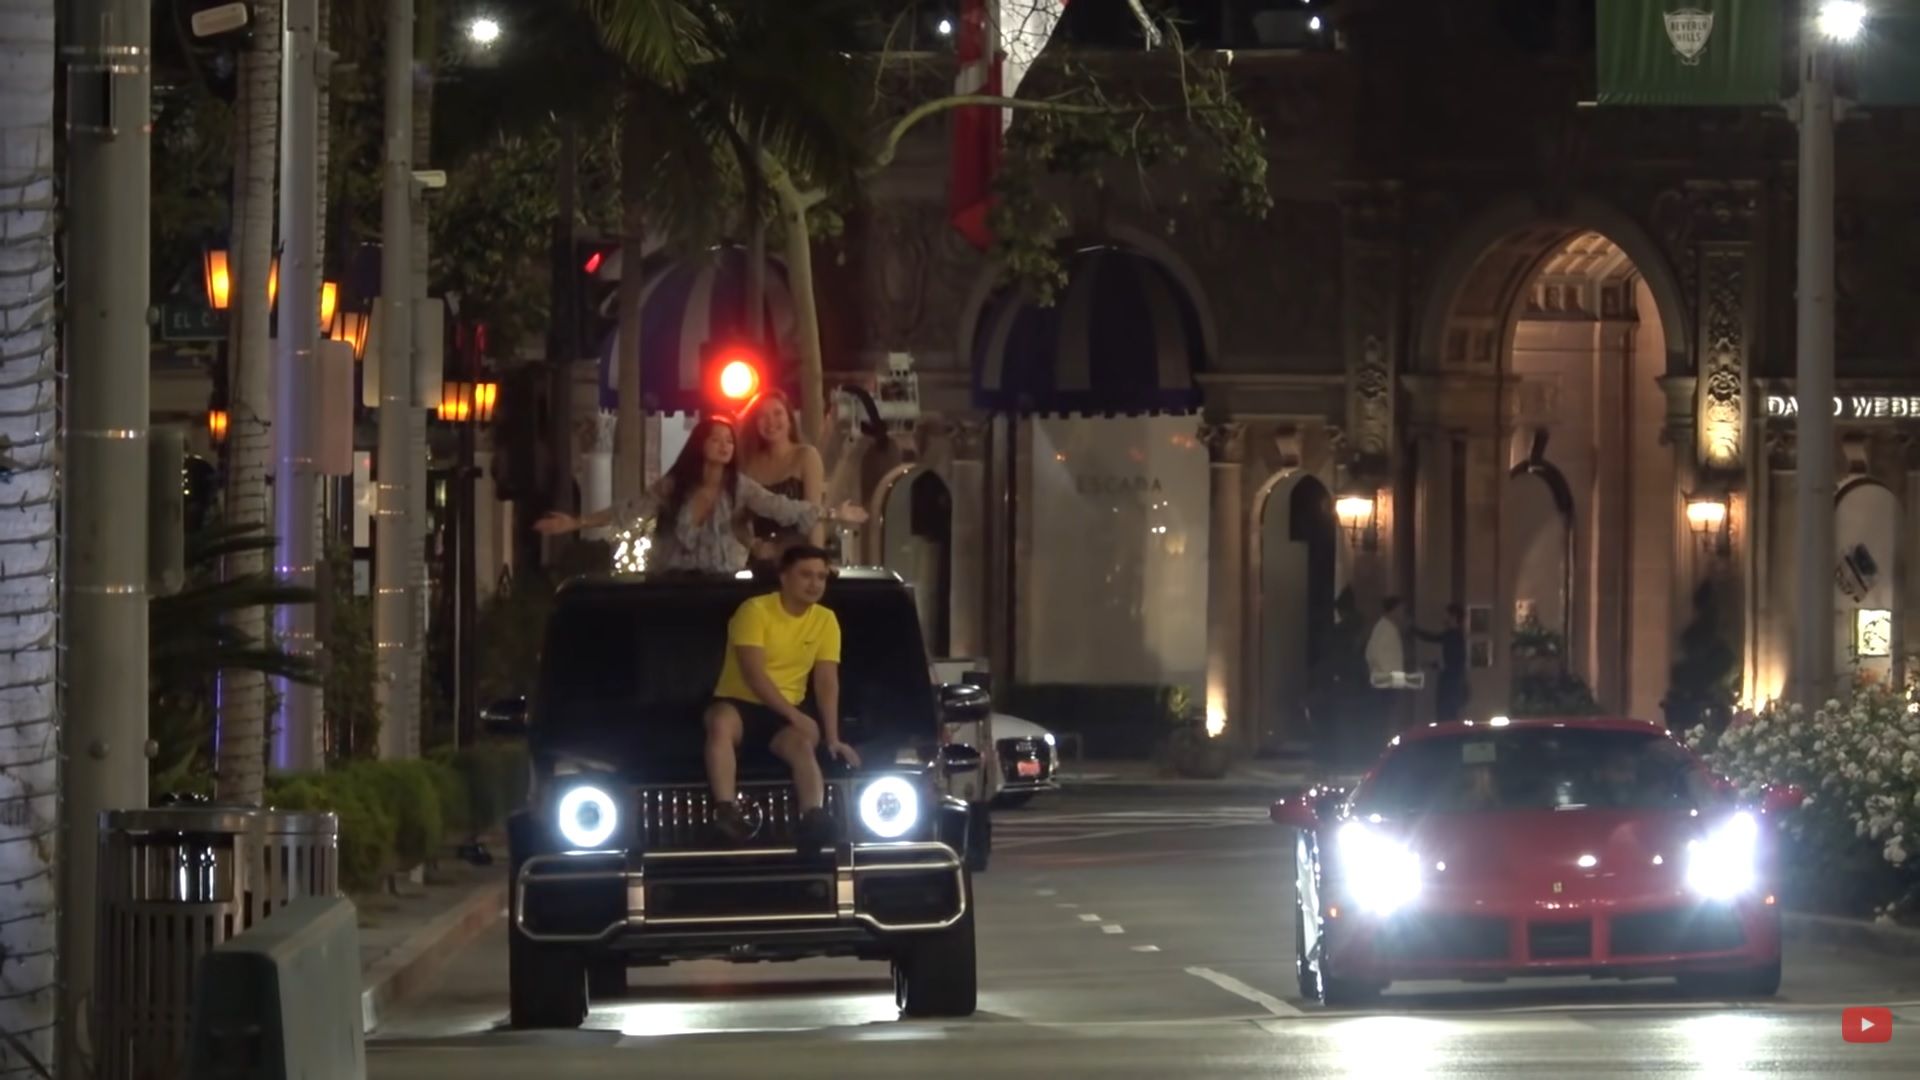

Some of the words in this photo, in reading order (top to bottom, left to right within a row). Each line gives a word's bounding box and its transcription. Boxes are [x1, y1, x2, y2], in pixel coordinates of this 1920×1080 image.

[1670, 21, 1707, 31] BEVERLY
[1676, 32, 1701, 42] HILLS
[173, 311, 192, 329] EL
[1767, 396, 1843, 416] DAD
[1077, 475, 1163, 495] ESCADA
